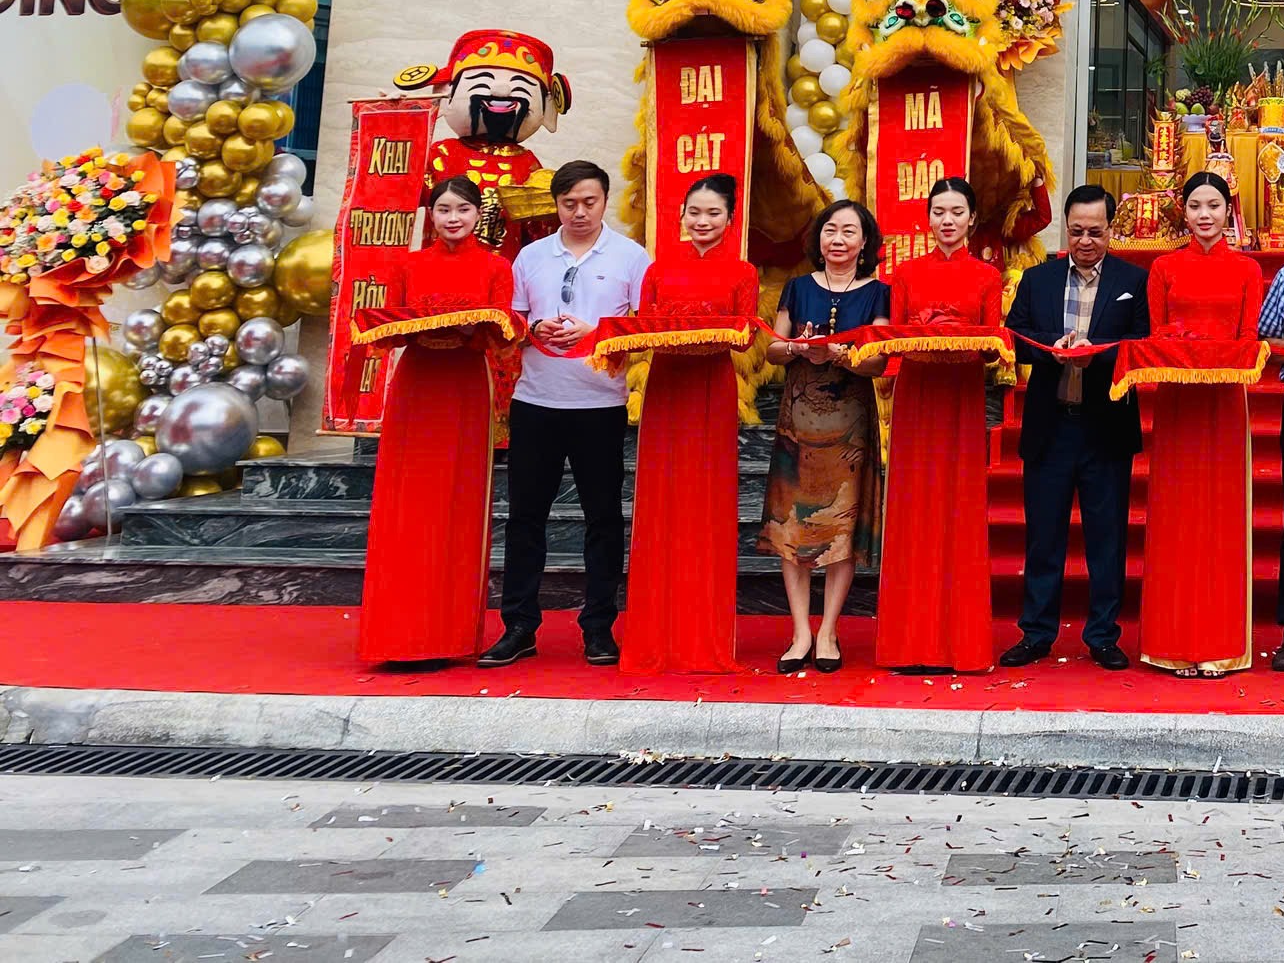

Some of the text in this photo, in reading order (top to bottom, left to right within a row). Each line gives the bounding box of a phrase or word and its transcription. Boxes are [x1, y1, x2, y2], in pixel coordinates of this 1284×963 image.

[680, 65, 723, 108] ĐẠI
[904, 85, 943, 131] MÃ
[676, 125, 725, 173] CÁT
